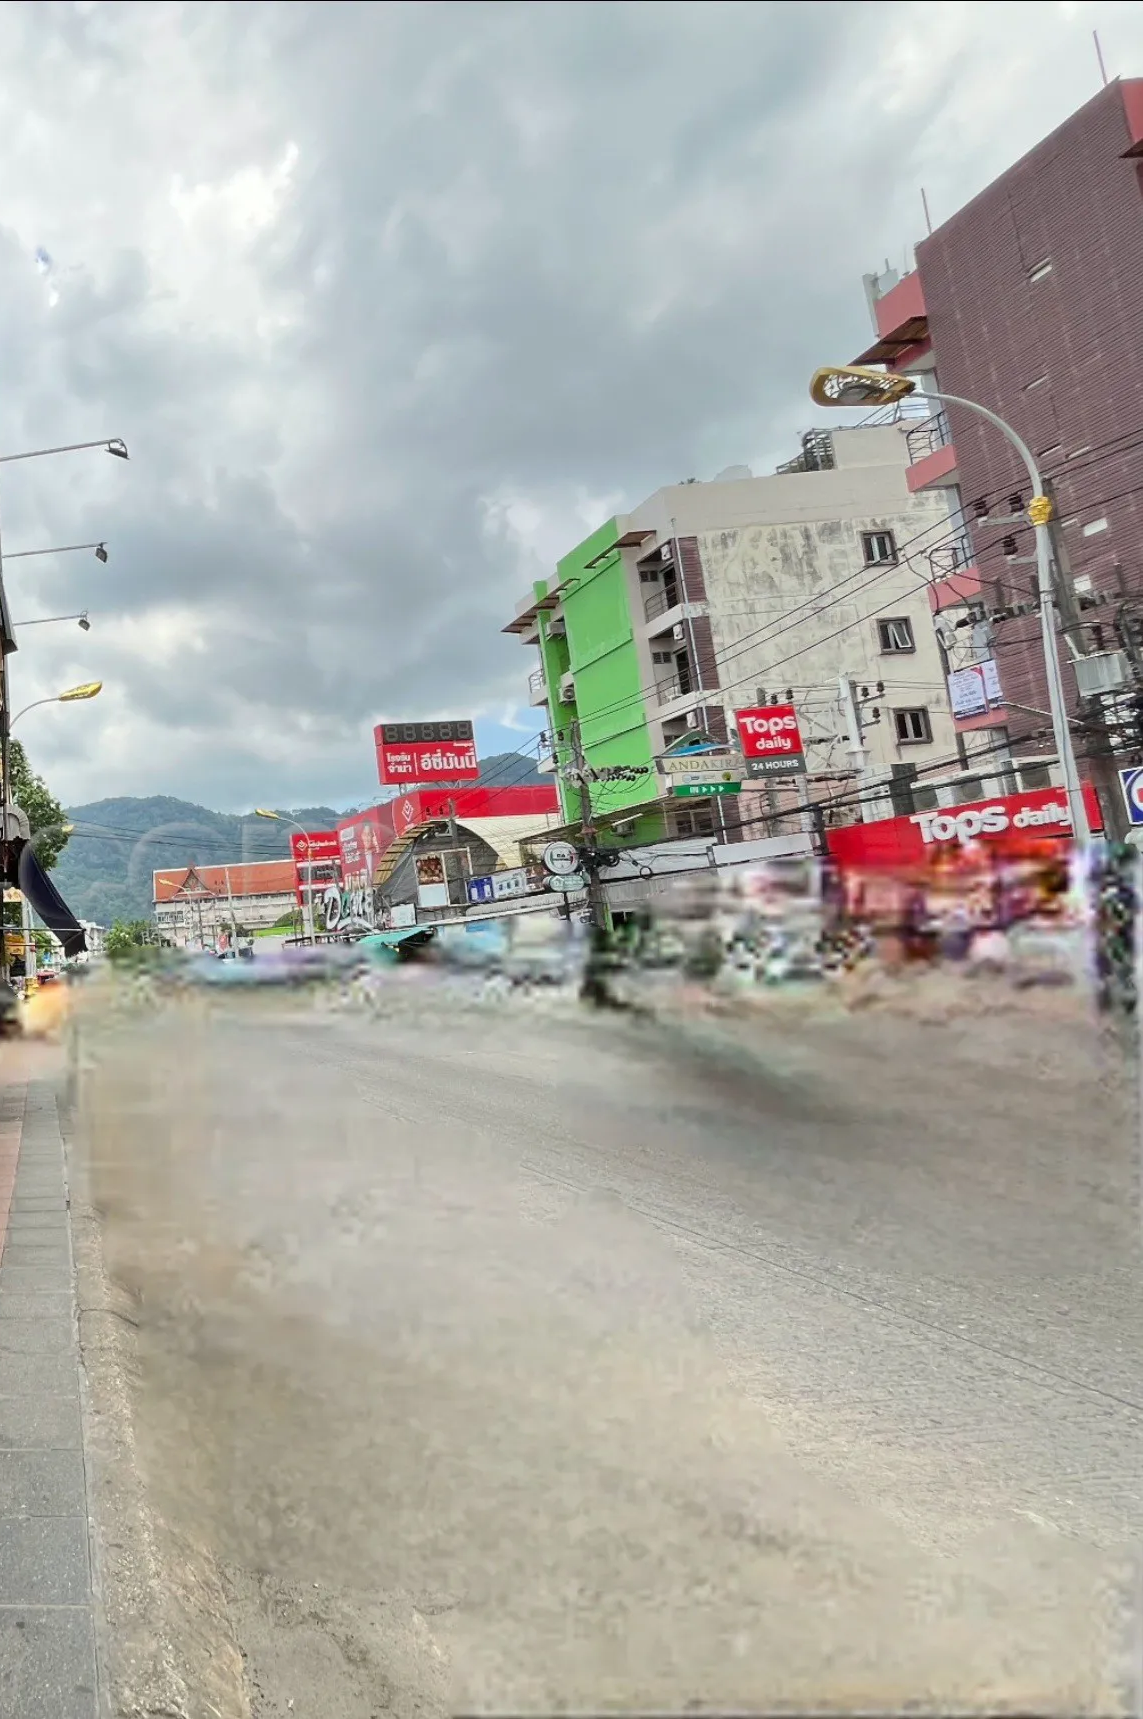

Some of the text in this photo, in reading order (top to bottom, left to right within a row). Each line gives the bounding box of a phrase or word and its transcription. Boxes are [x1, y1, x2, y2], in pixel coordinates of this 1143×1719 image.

[739, 715, 798, 736] Tops
[755, 736, 792, 750] daily
[751, 759, 799, 771] 24 HOURS
[909, 802, 1071, 844] Tops daily
